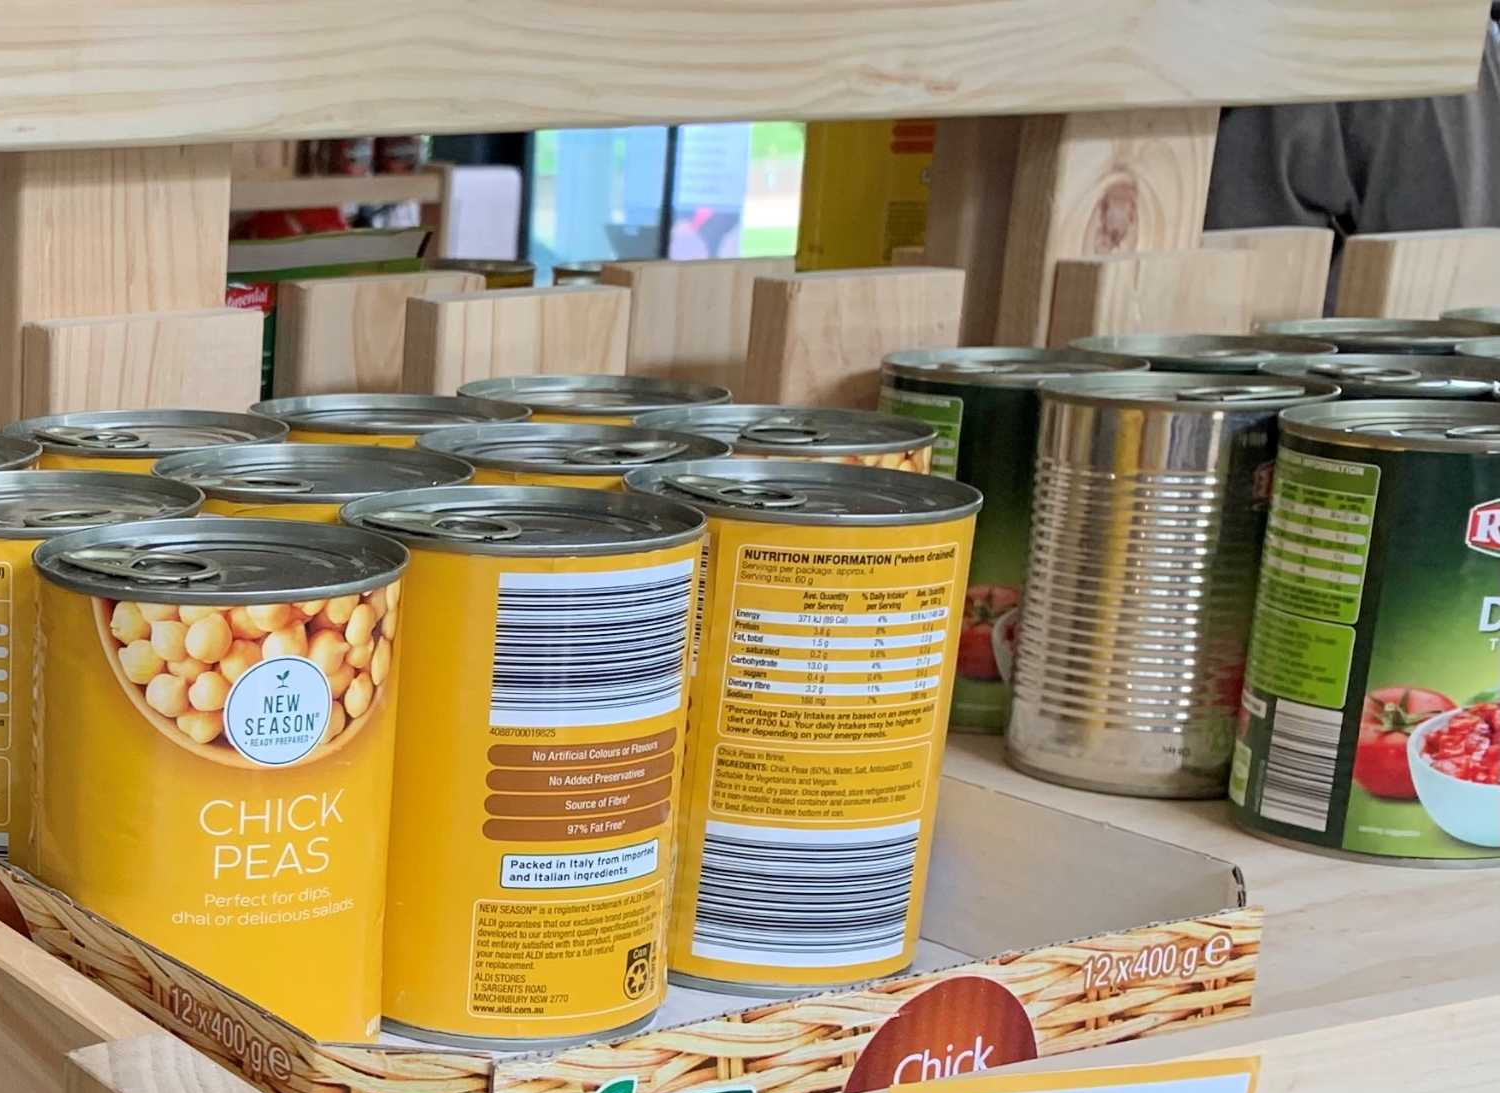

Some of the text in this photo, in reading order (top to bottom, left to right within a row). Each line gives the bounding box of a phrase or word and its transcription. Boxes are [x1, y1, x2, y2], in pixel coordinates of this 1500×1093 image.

[1471, 509, 1500, 545] R
[744, 549, 810, 564] NUTRITION
[813, 554, 892, 566] INFORMATION
[740, 570, 772, 582] Serving
[741, 561, 777, 573] Servings
[780, 566, 793, 574] per
[736, 609, 761, 620] Energy
[1478, 595, 1500, 632] D
[263, 694, 300, 714] NEW
[532, 740, 658, 762] No Artificial Colours or Flavours
[548, 768, 646, 787] No Added Preservatives
[199, 788, 345, 836] CHICK
[565, 798, 597, 811] Source
[598, 797, 607, 808] of
[567, 823, 588, 835] 97%
[589, 821, 604, 834] Fat
[212, 836, 331, 880] PEAS
[510, 846, 654, 870] Packed in Italy from imported
[509, 865, 628, 882] and Italian ingredients
[203, 886, 331, 908] Perfect for dips
[171, 897, 355, 926] dhal or delicious salads
[475, 973, 526, 983] ALDI STORES
[482, 983, 523, 993] SARGENTS
[525, 984, 547, 994] ROAD
[529, 995, 548, 1003] NSW
[473, 1005, 544, 1014] www.aldi.com.au
[893, 1037, 994, 1084] Chick
